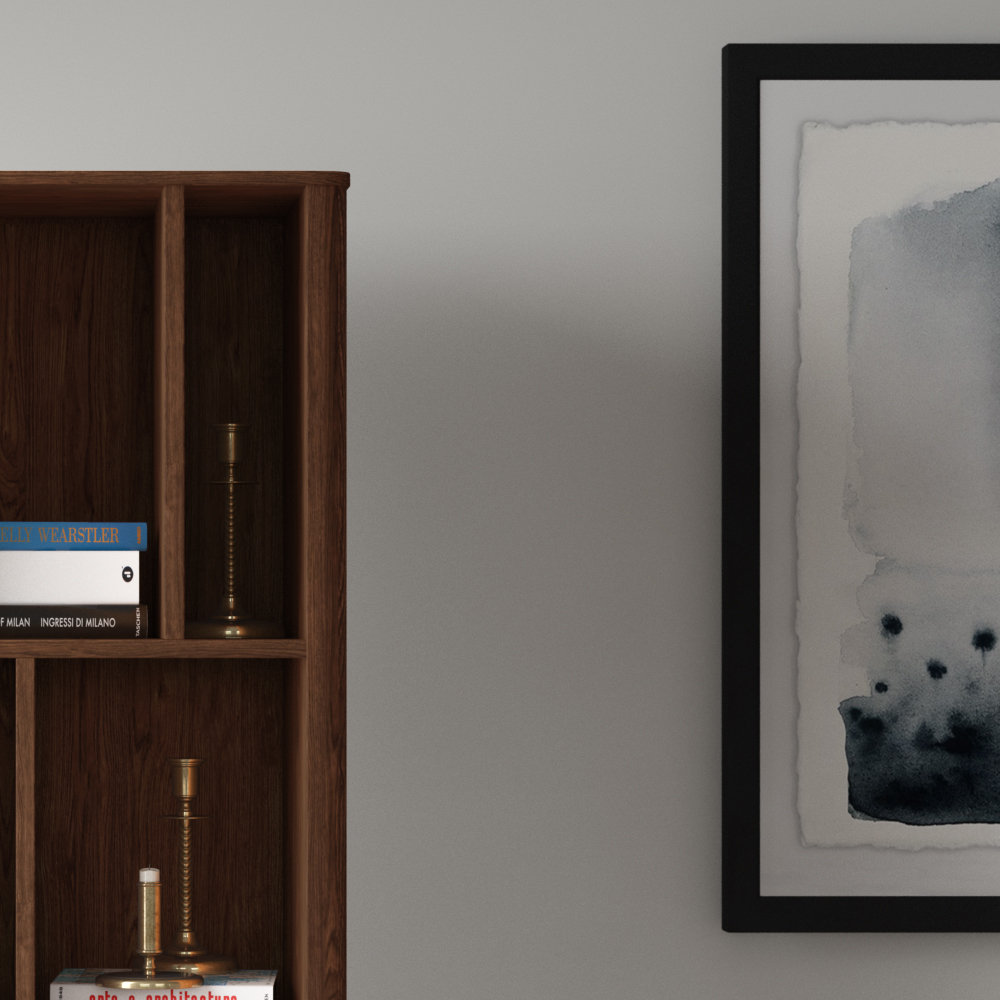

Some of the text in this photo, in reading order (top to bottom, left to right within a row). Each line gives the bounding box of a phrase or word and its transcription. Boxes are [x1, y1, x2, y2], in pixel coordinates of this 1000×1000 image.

[38, 527, 119, 544] WEARSTLER
[6, 616, 31, 627] MILAN
[40, 617, 116, 628] INGRESSI DI MILANO
